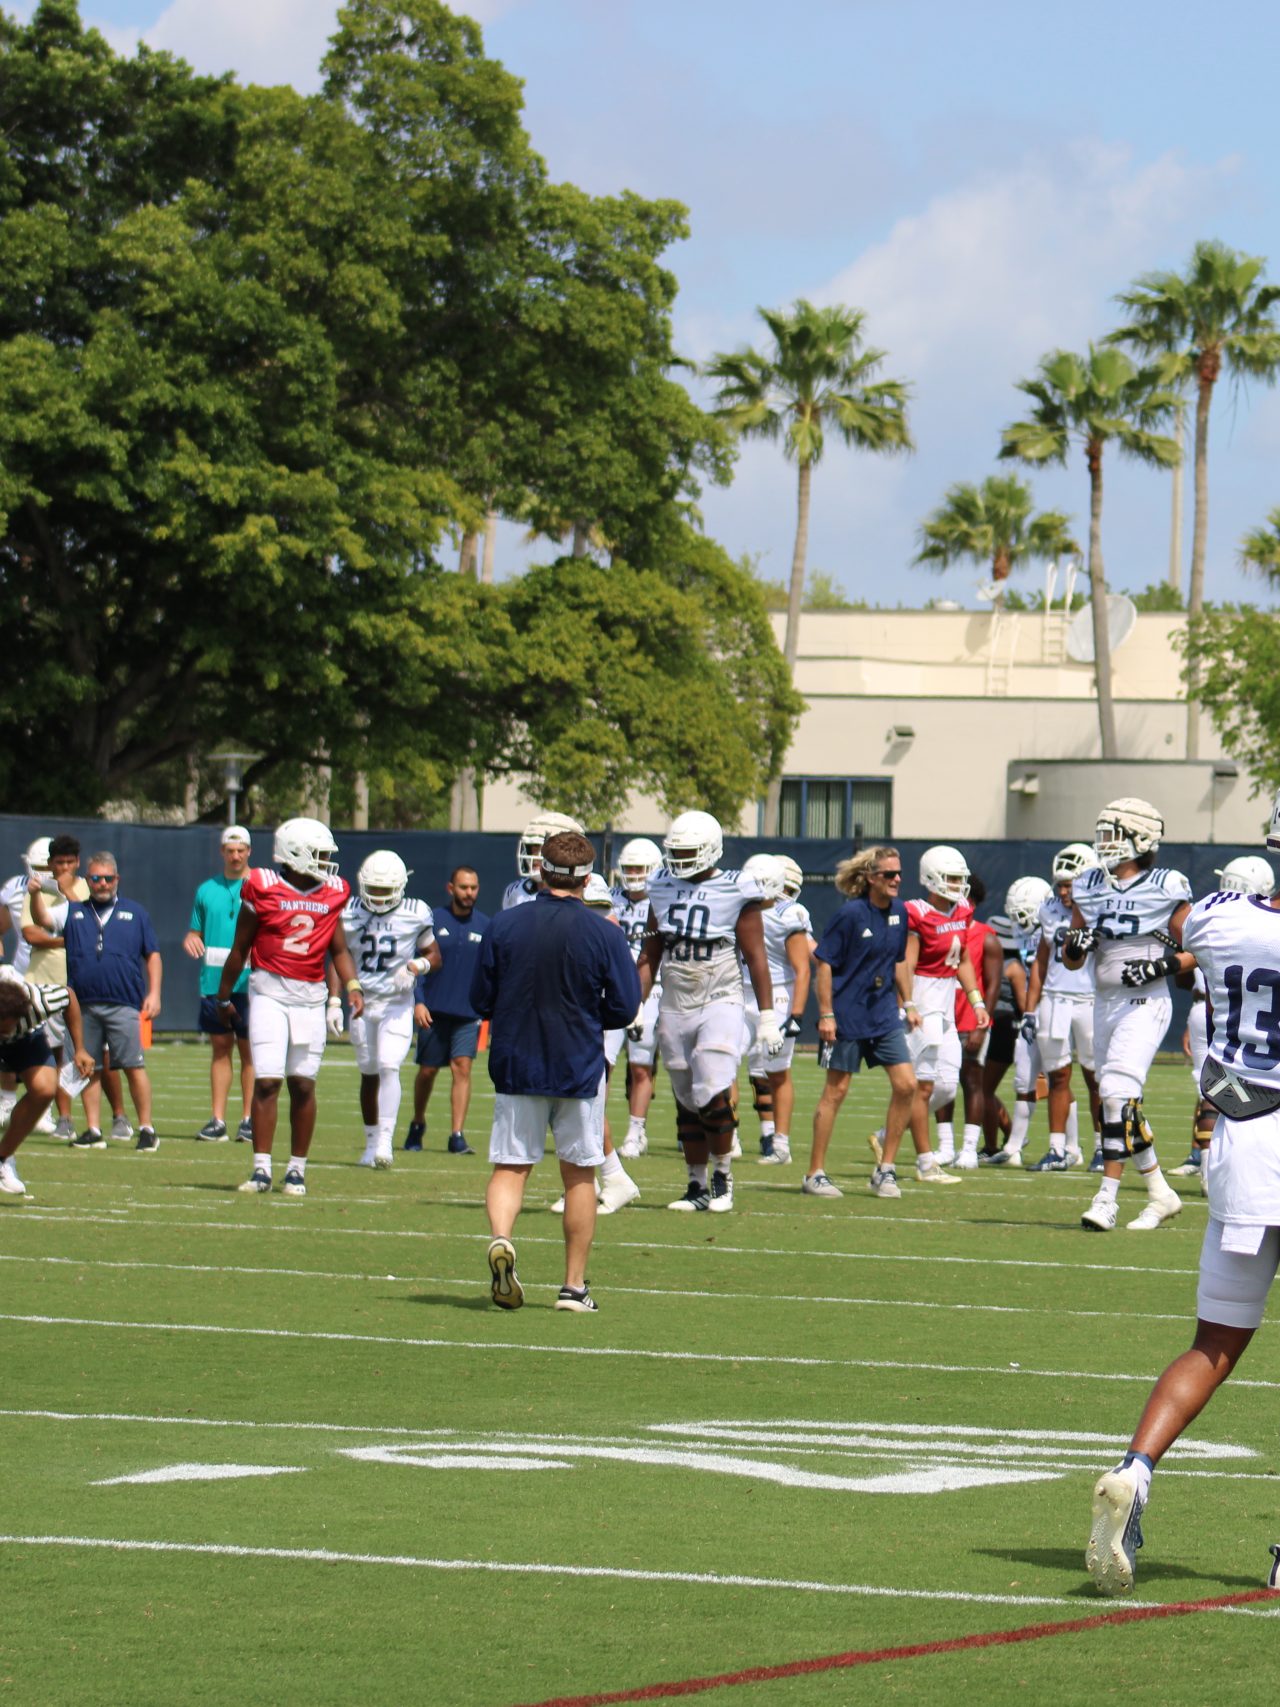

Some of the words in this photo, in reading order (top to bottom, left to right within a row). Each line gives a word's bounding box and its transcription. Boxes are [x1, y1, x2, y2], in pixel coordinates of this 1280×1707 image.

[676, 889, 708, 900] FIU
[1106, 900, 1135, 910] FIU
[281, 901, 329, 914] PANTHERS
[283, 914, 315, 955] 2
[360, 935, 397, 972] 22
[945, 934, 961, 969] 4
